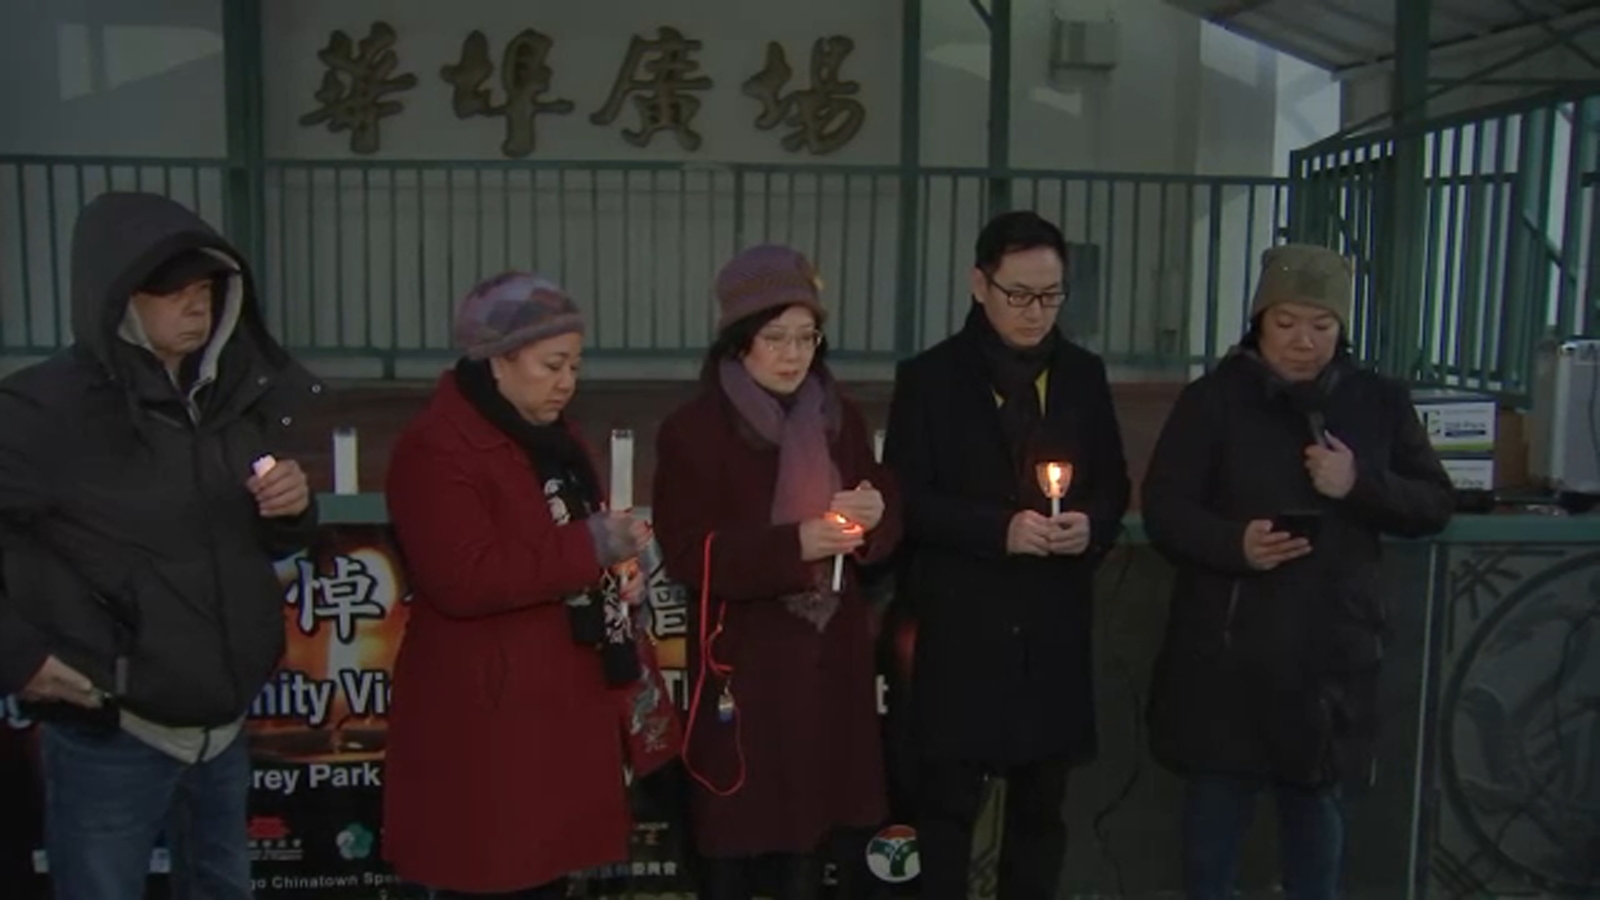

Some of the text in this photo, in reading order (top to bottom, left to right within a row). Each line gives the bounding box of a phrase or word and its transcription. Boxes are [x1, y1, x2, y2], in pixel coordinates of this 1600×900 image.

[284, 555, 385, 642] 悼
[341, 671, 392, 715] Vi
[308, 762, 382, 789] Park
[271, 873, 359, 890] Chinatown
